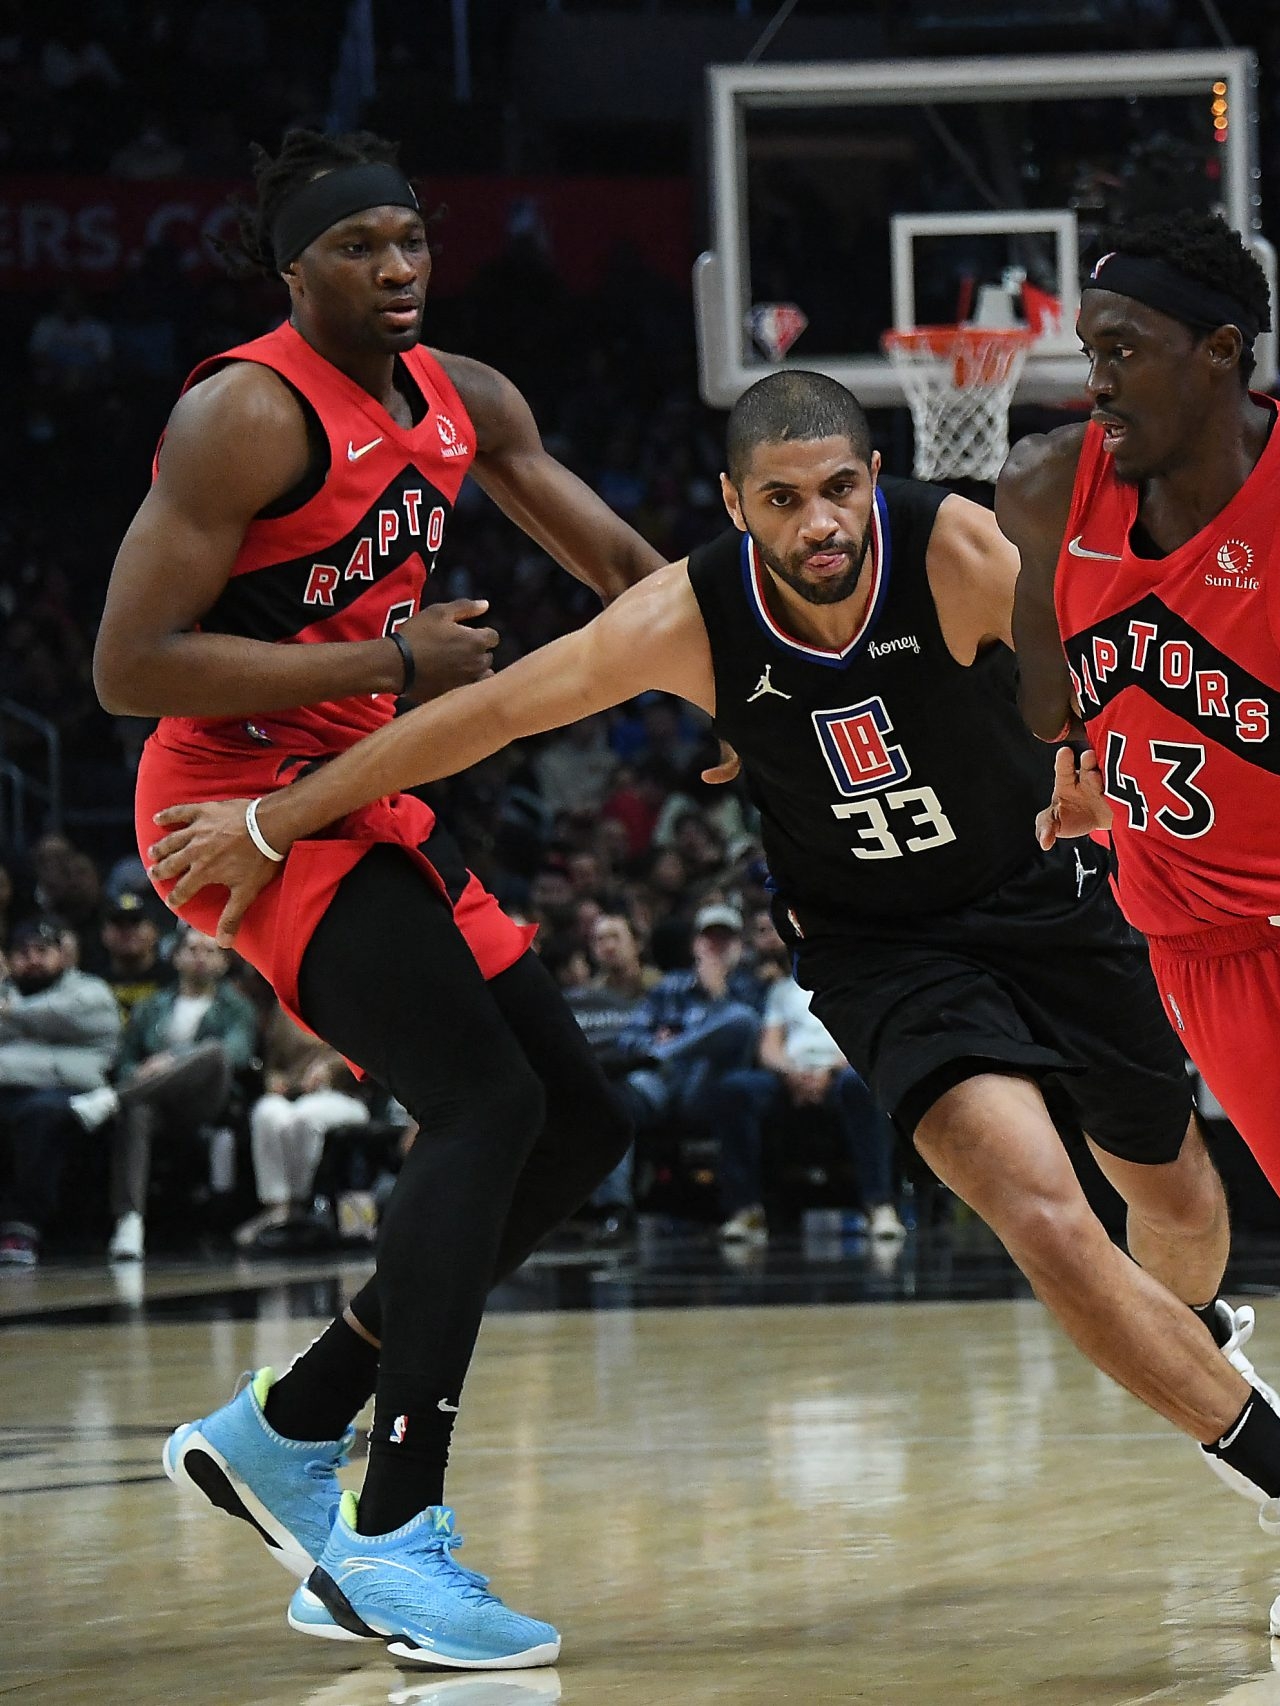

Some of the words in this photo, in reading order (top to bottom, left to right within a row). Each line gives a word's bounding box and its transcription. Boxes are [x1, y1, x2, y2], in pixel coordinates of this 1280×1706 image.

[303, 489, 445, 606] RAPTO
[1204, 574, 1232, 587] Sun
[1235, 576, 1260, 590] Life
[867, 635, 921, 659] honey
[1104, 731, 1215, 839] 43
[830, 786, 957, 859] 33
